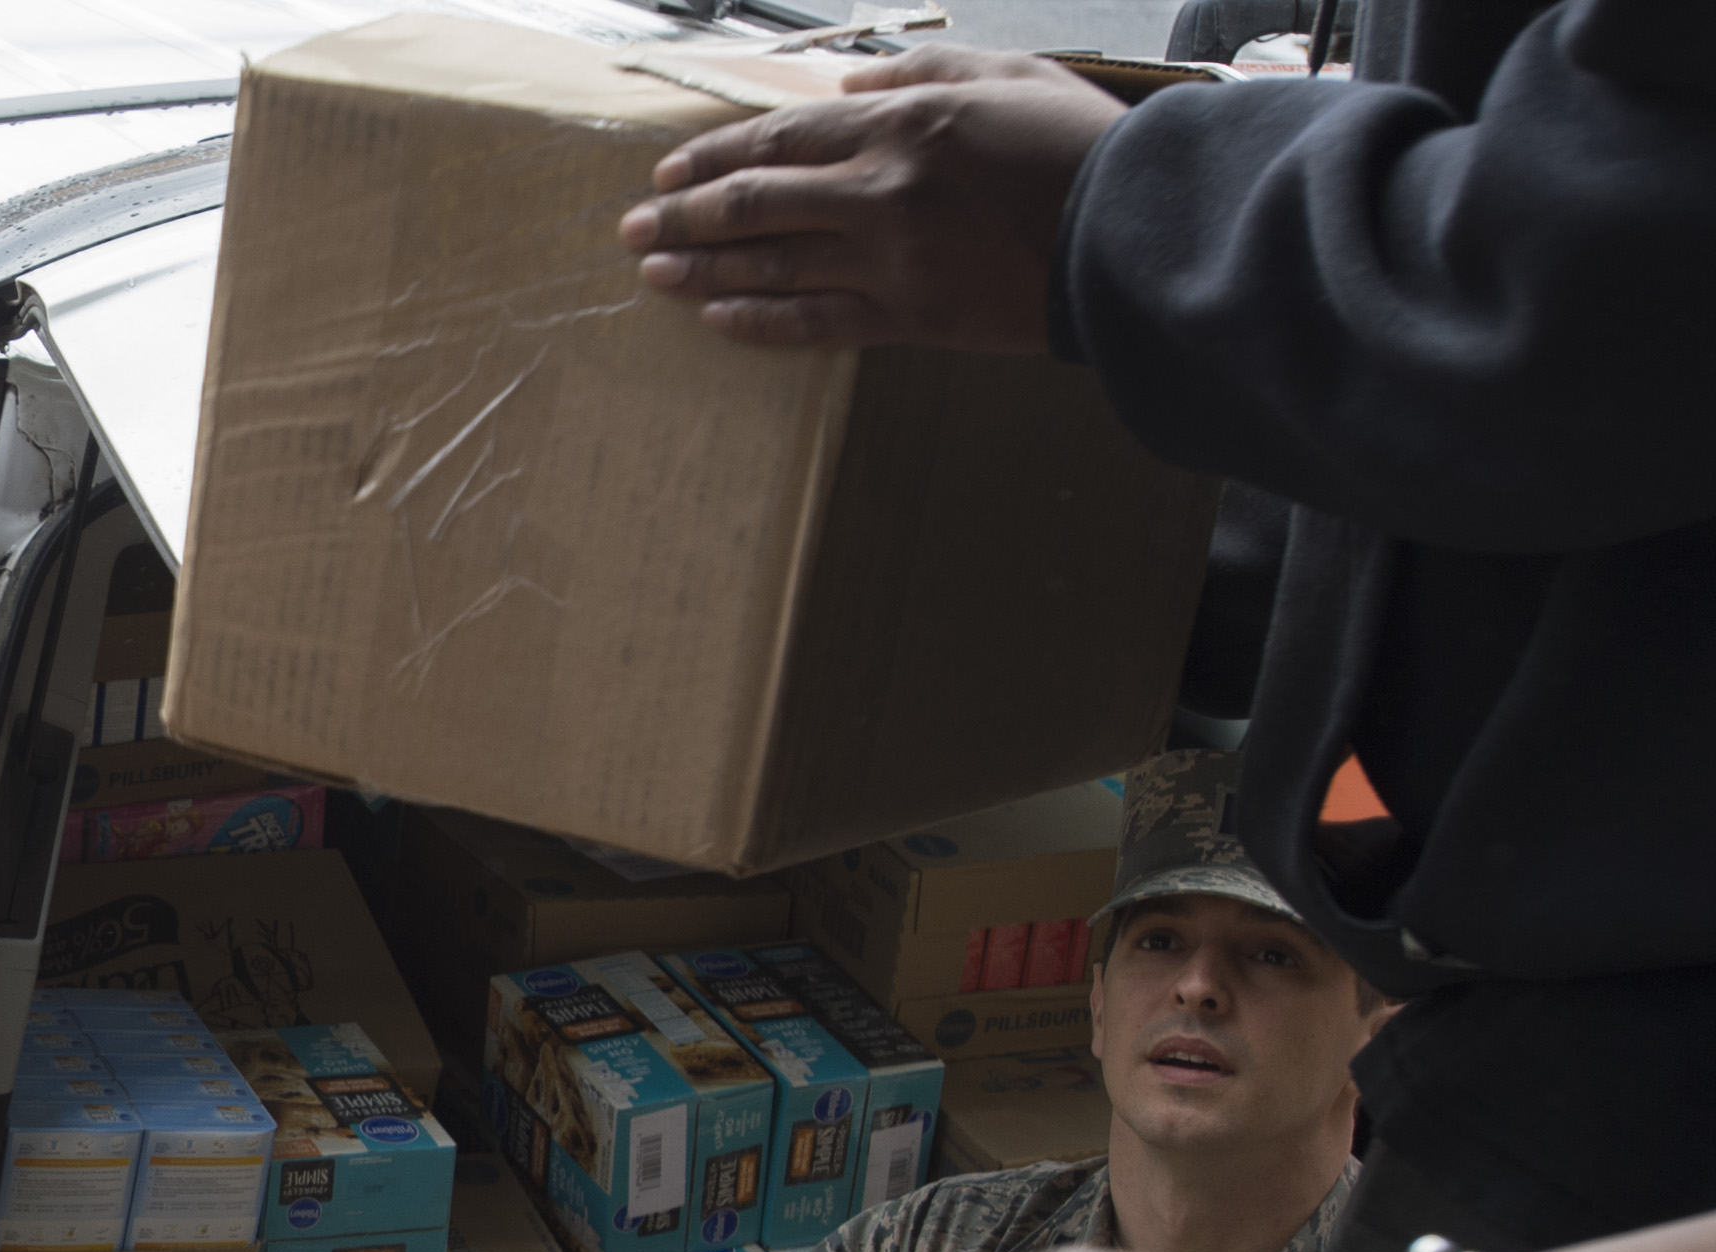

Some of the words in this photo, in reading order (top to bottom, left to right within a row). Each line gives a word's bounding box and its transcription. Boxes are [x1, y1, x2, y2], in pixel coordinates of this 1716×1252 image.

[109, 759, 215, 787] PILLSBURY
[334, 1091, 403, 1110] SIMPLE
[362, 1119, 417, 1137] Pillsbury
[813, 1127, 836, 1175] SIMPLE
[286, 1168, 329, 1186] SIMPLE
[716, 1160, 738, 1207] SIMPLE
